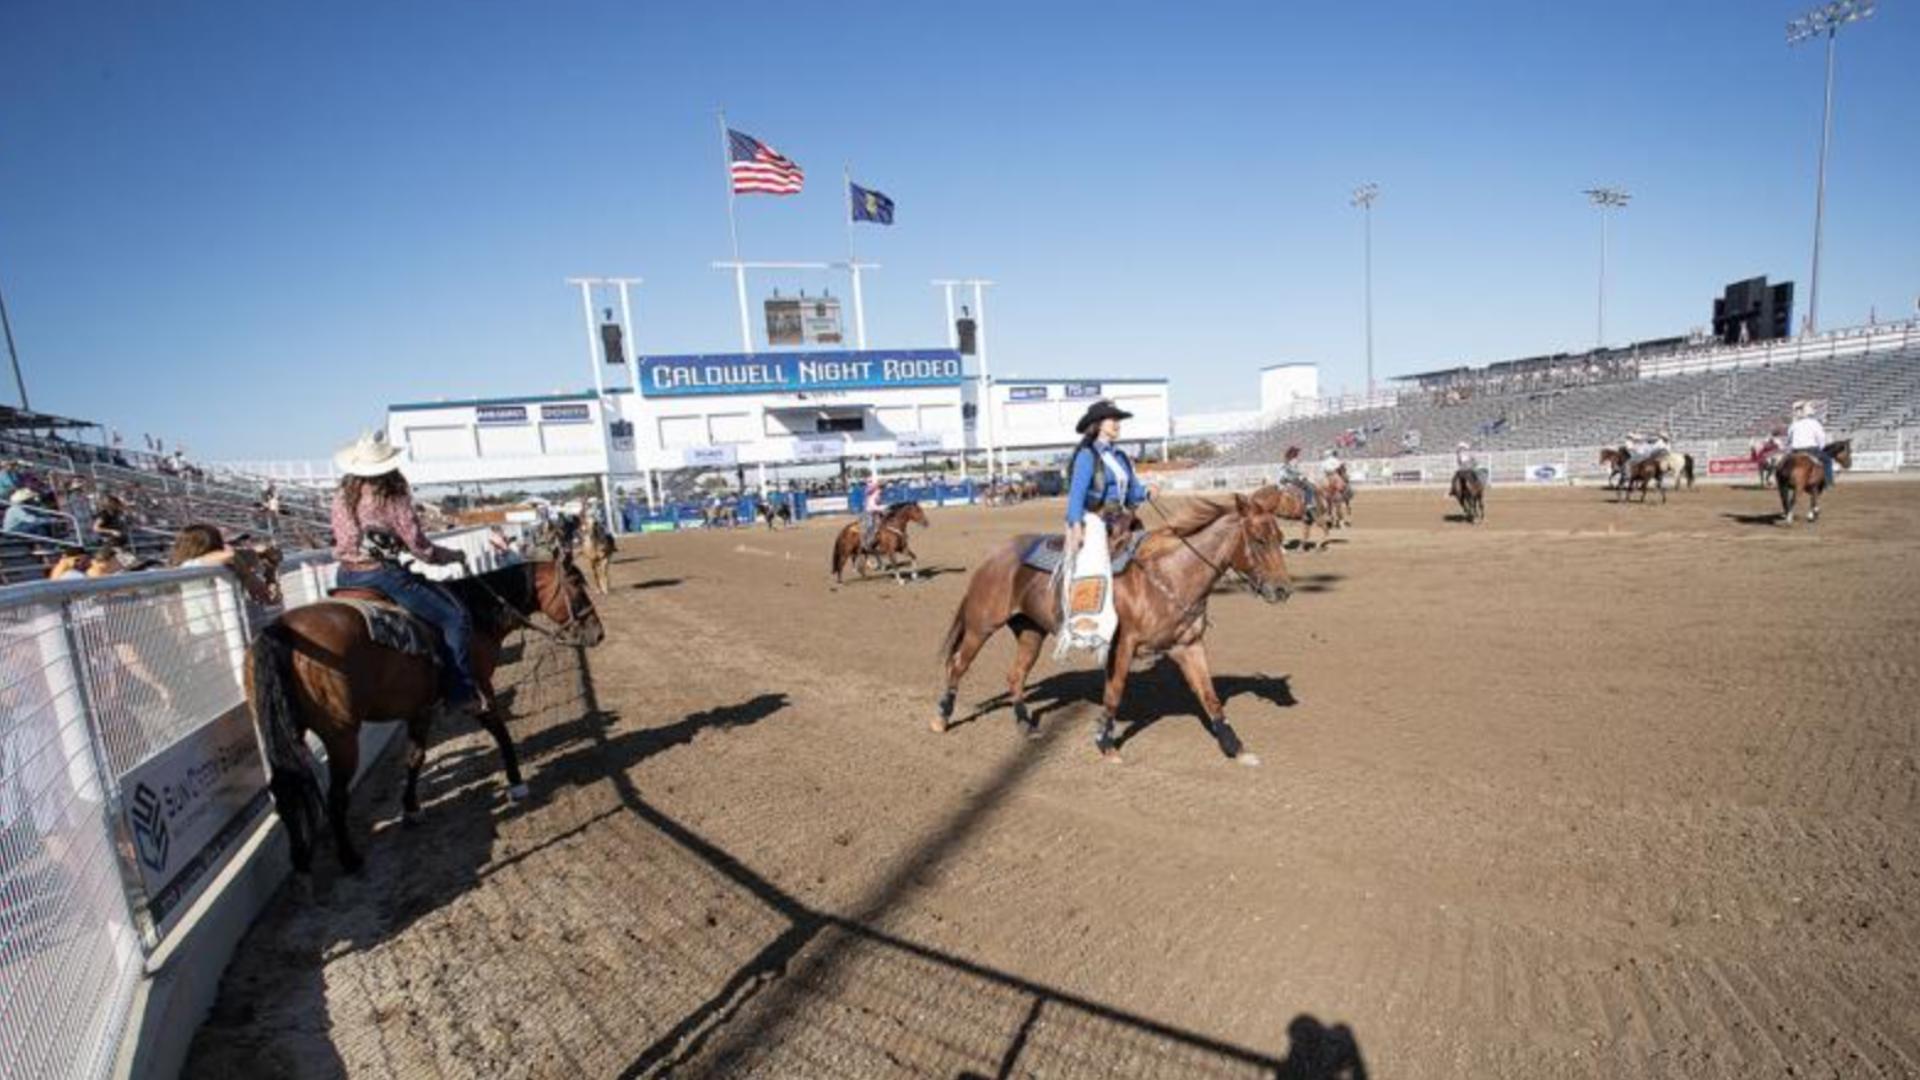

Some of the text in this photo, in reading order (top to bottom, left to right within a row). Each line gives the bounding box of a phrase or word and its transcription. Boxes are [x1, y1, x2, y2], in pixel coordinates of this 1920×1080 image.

[652, 358, 959, 389] CALDWELL NIGHT RODEO
